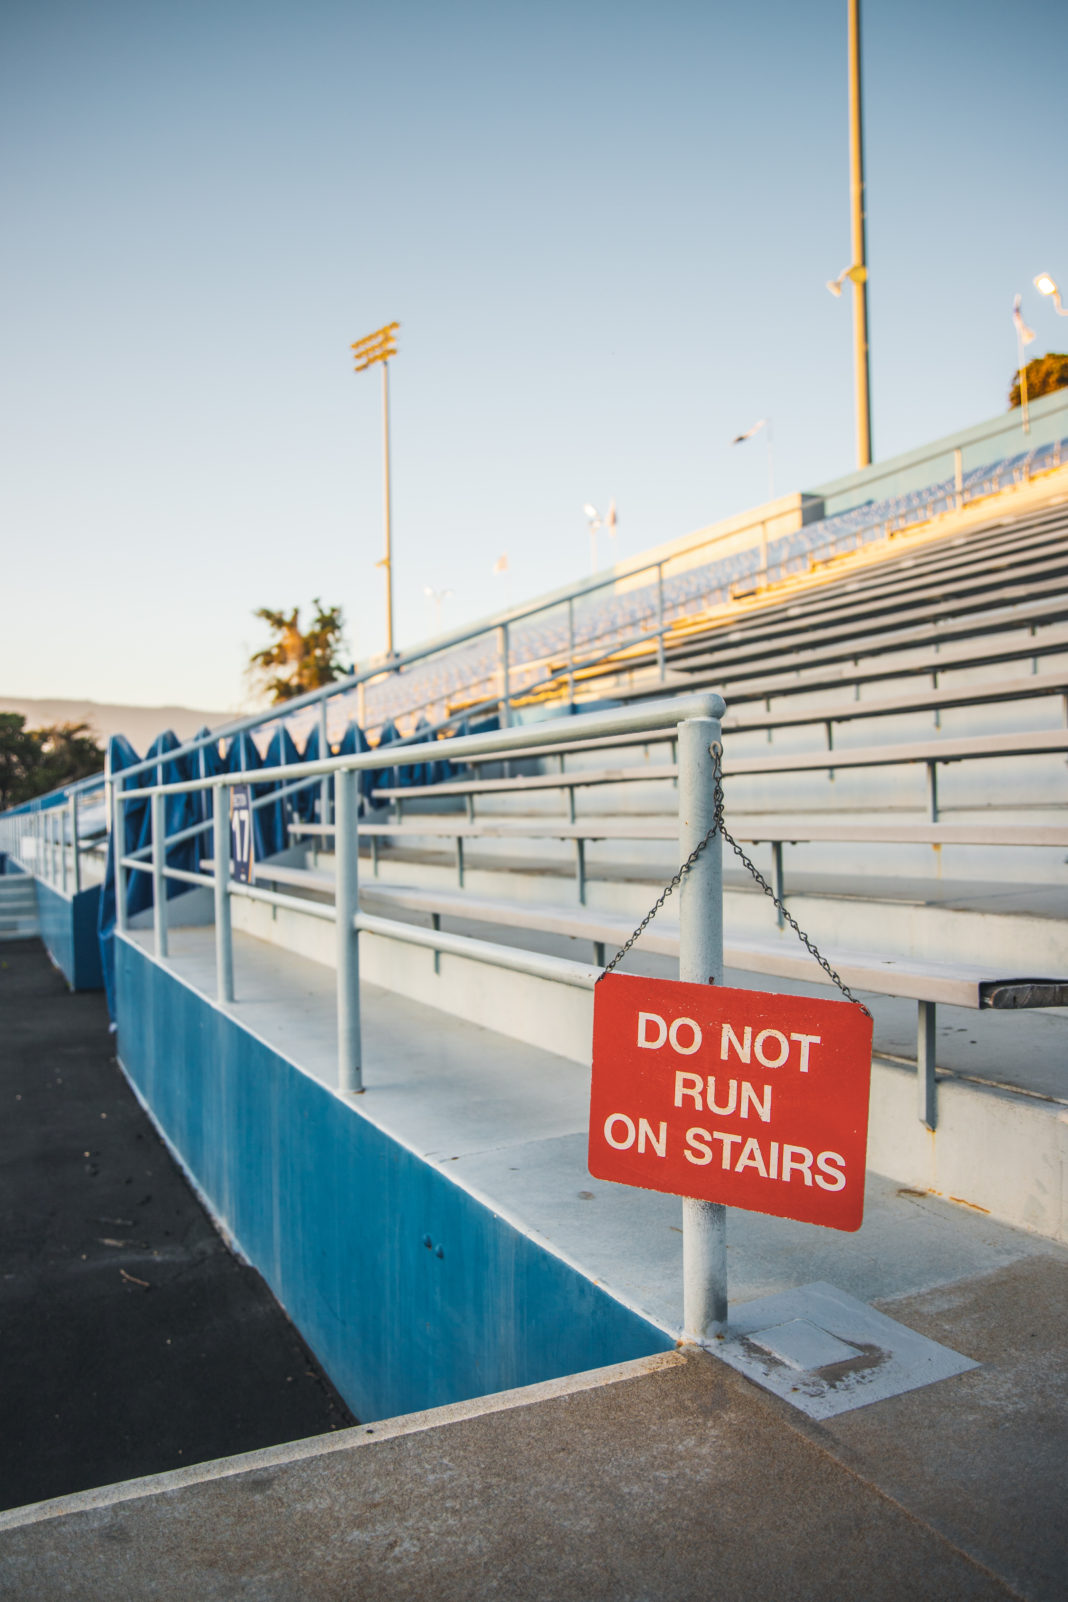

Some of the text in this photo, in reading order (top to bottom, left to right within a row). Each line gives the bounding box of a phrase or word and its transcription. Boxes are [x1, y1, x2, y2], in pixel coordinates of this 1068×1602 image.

[232, 809, 249, 862] 17
[637, 1011, 821, 1073] DO NOT
[674, 1071, 772, 1123] RUN
[603, 1113, 846, 1192] ON STAIRS
